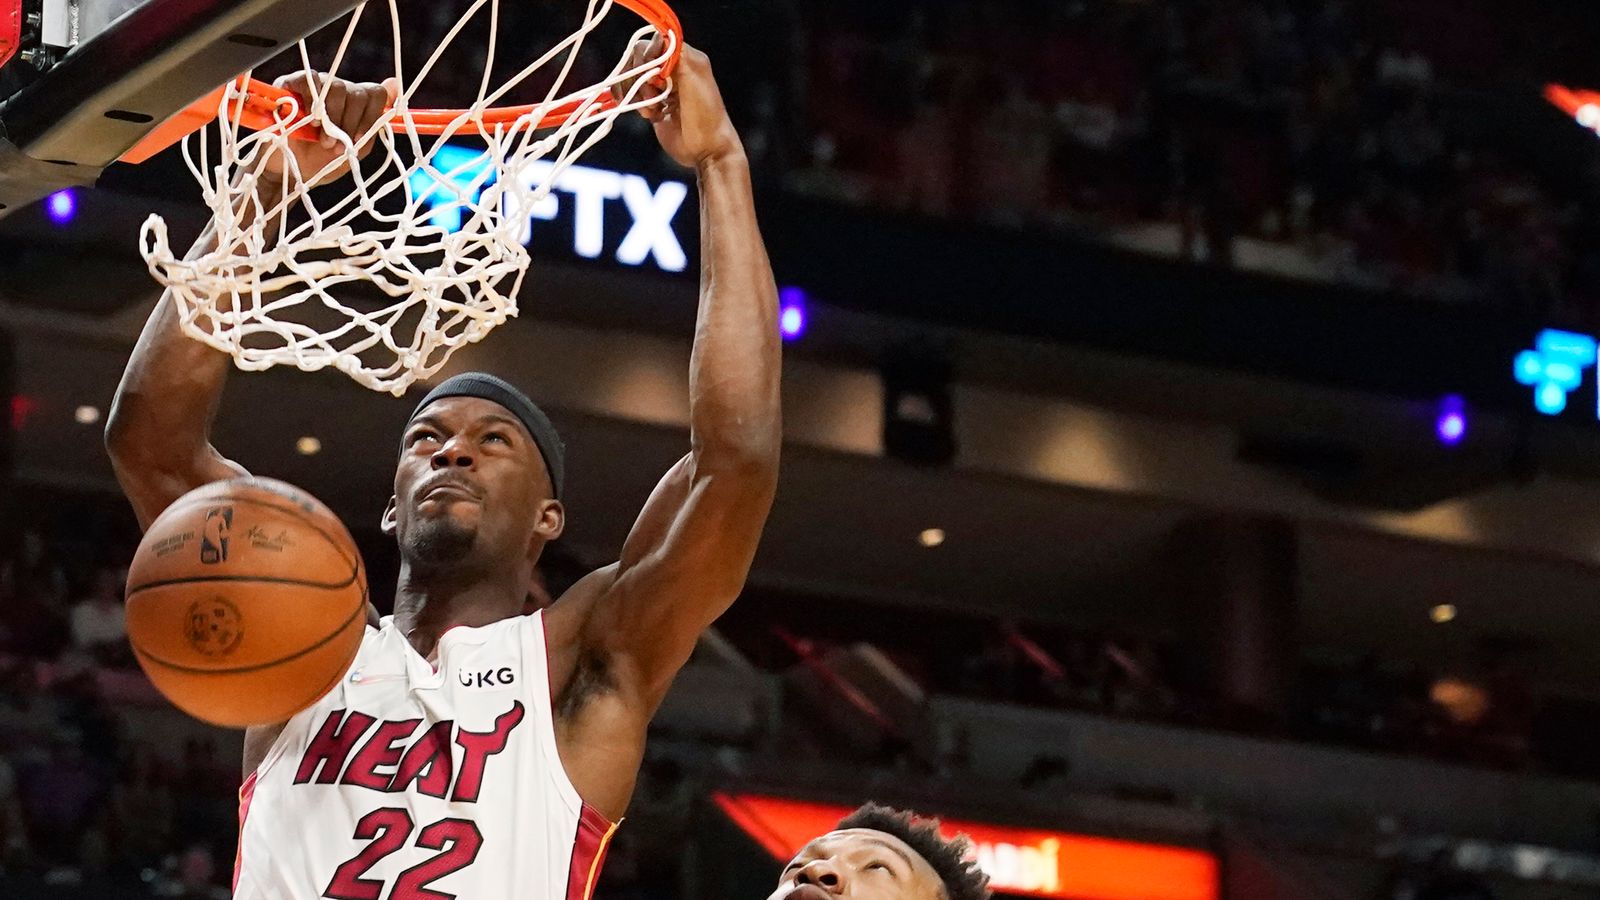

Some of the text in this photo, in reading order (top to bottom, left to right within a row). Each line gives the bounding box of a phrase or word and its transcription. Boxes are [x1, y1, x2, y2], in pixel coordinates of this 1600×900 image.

[502, 157, 688, 272] FTX
[293, 699, 526, 803] HEAT
[322, 807, 484, 900] 22
